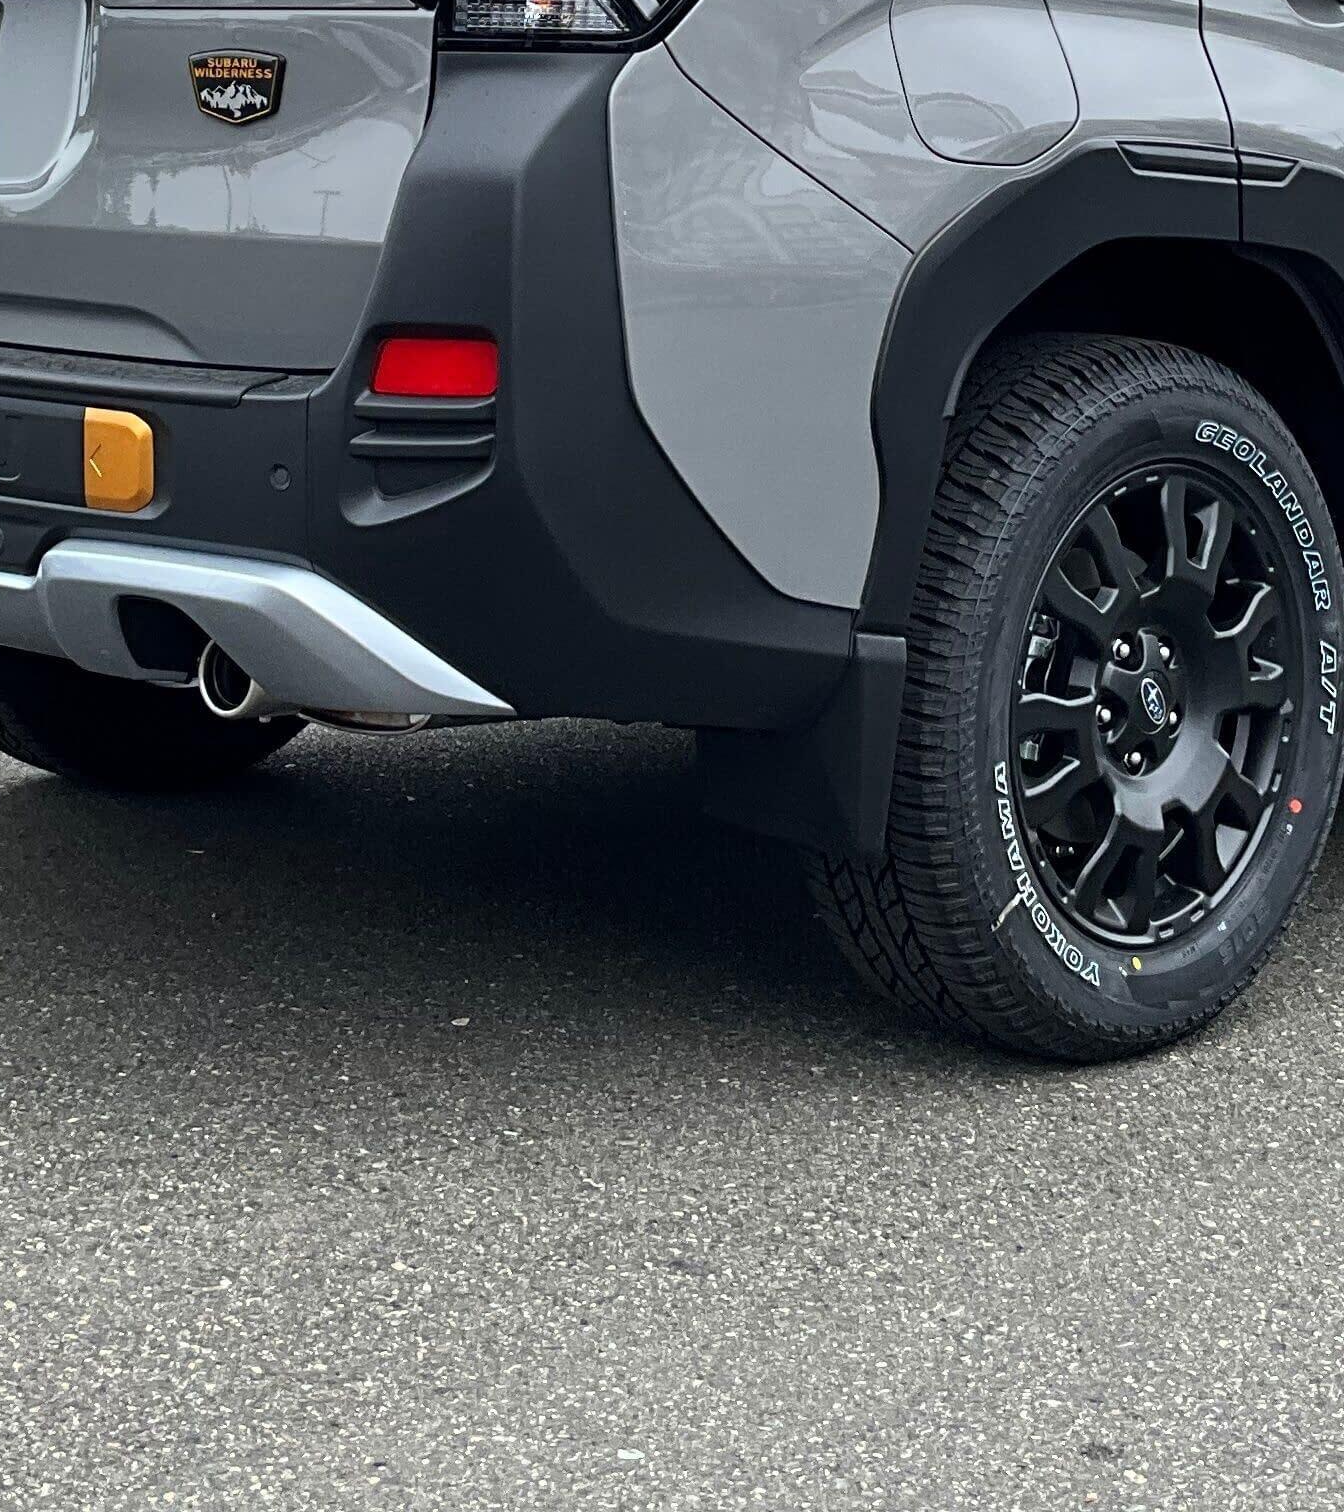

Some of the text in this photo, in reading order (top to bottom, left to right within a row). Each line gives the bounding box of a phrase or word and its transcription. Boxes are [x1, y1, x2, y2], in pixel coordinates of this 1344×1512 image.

[194, 68, 273, 79] WILDERNESS
[207, 57, 257, 68] SUBARU
[1195, 420, 1338, 735] GEOLANDAR A/T
[994, 761, 1101, 987] YOKOHAMA
